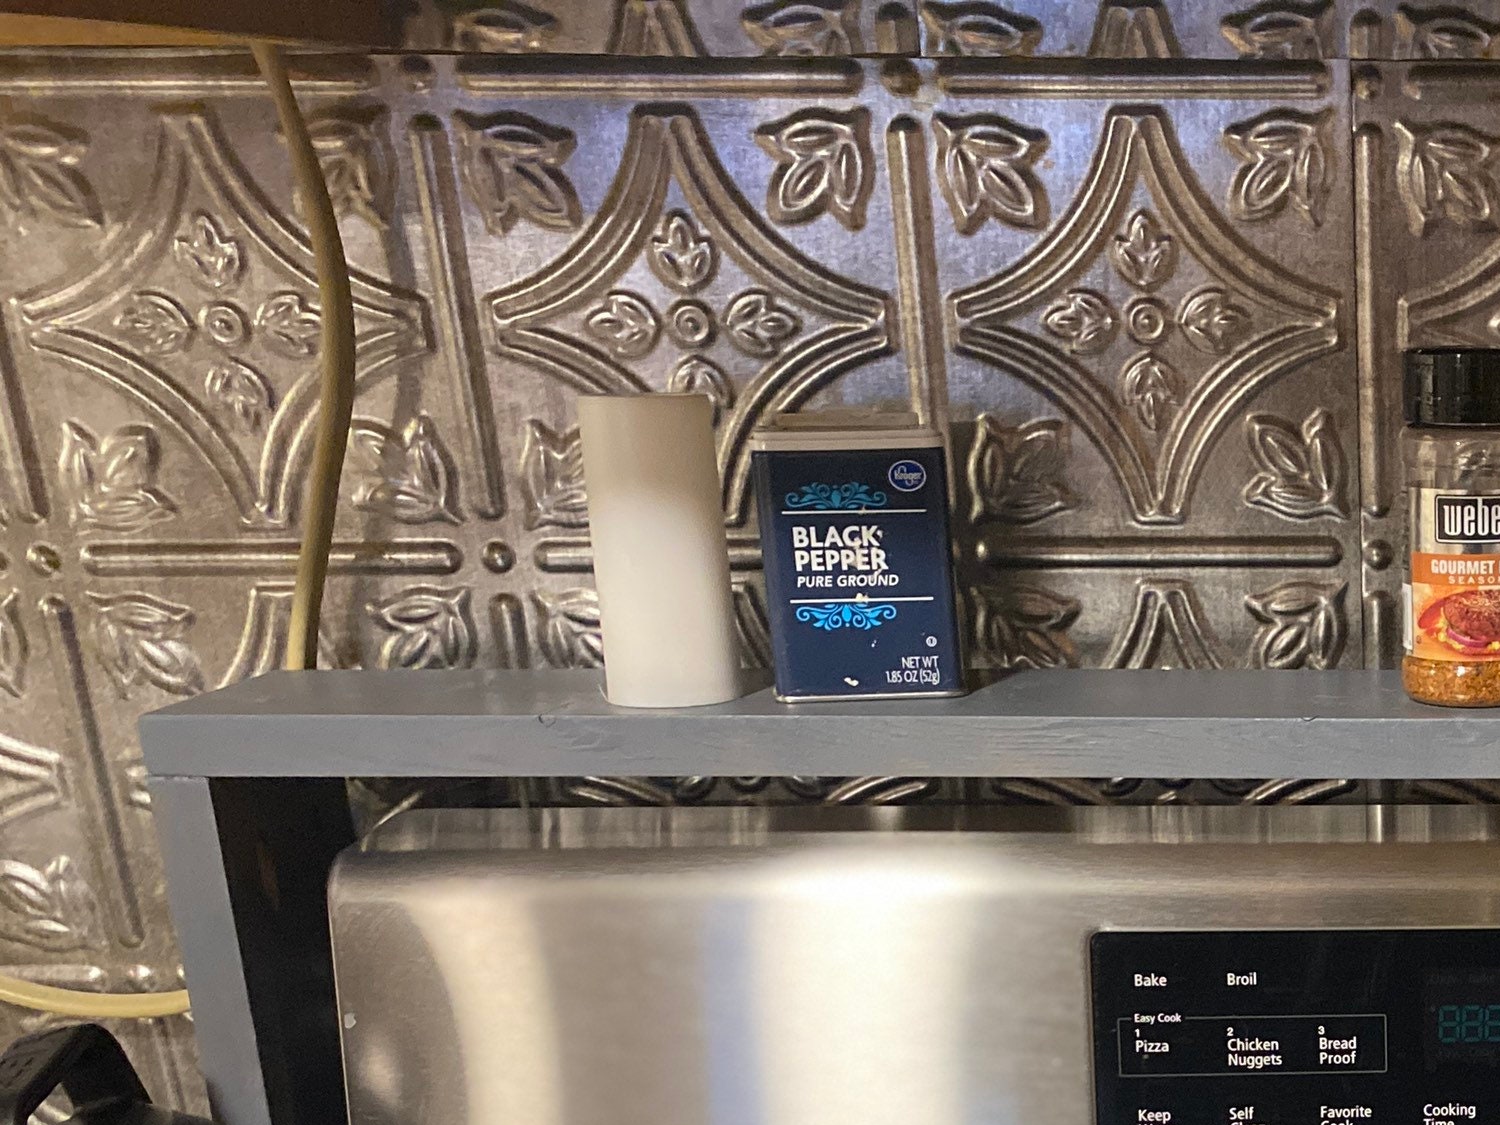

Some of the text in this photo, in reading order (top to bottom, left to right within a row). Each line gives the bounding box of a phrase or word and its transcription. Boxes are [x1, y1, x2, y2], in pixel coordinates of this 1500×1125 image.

[792, 525, 882, 548] BLACK
[794, 547, 889, 571] PEPPER
[1430, 559, 1496, 575] GOURMET
[797, 574, 899, 588] PURE GROUND
[901, 655, 939, 669] NET WT
[903, 670, 919, 683] OZ
[1133, 973, 1167, 987] Bake
[1226, 972, 1257, 986] Broil
[1133, 1012, 1182, 1025] Easy Cook
[1134, 1029, 1140, 1037] 1
[1226, 1027, 1234, 1036] 2
[1318, 1026, 1325, 1035] 3
[1135, 1039, 1170, 1053] Pizza
[1227, 1038, 1279, 1052] Chicken
[1318, 1037, 1357, 1050] Bread
[1228, 1053, 1283, 1068] Nuggets
[1319, 1051, 1356, 1064] Proof
[1138, 1109, 1171, 1125] Keep
[1230, 1107, 1254, 1120] Self
[1320, 1105, 1372, 1119] Favorite
[1423, 1104, 1476, 1119] Cooking
